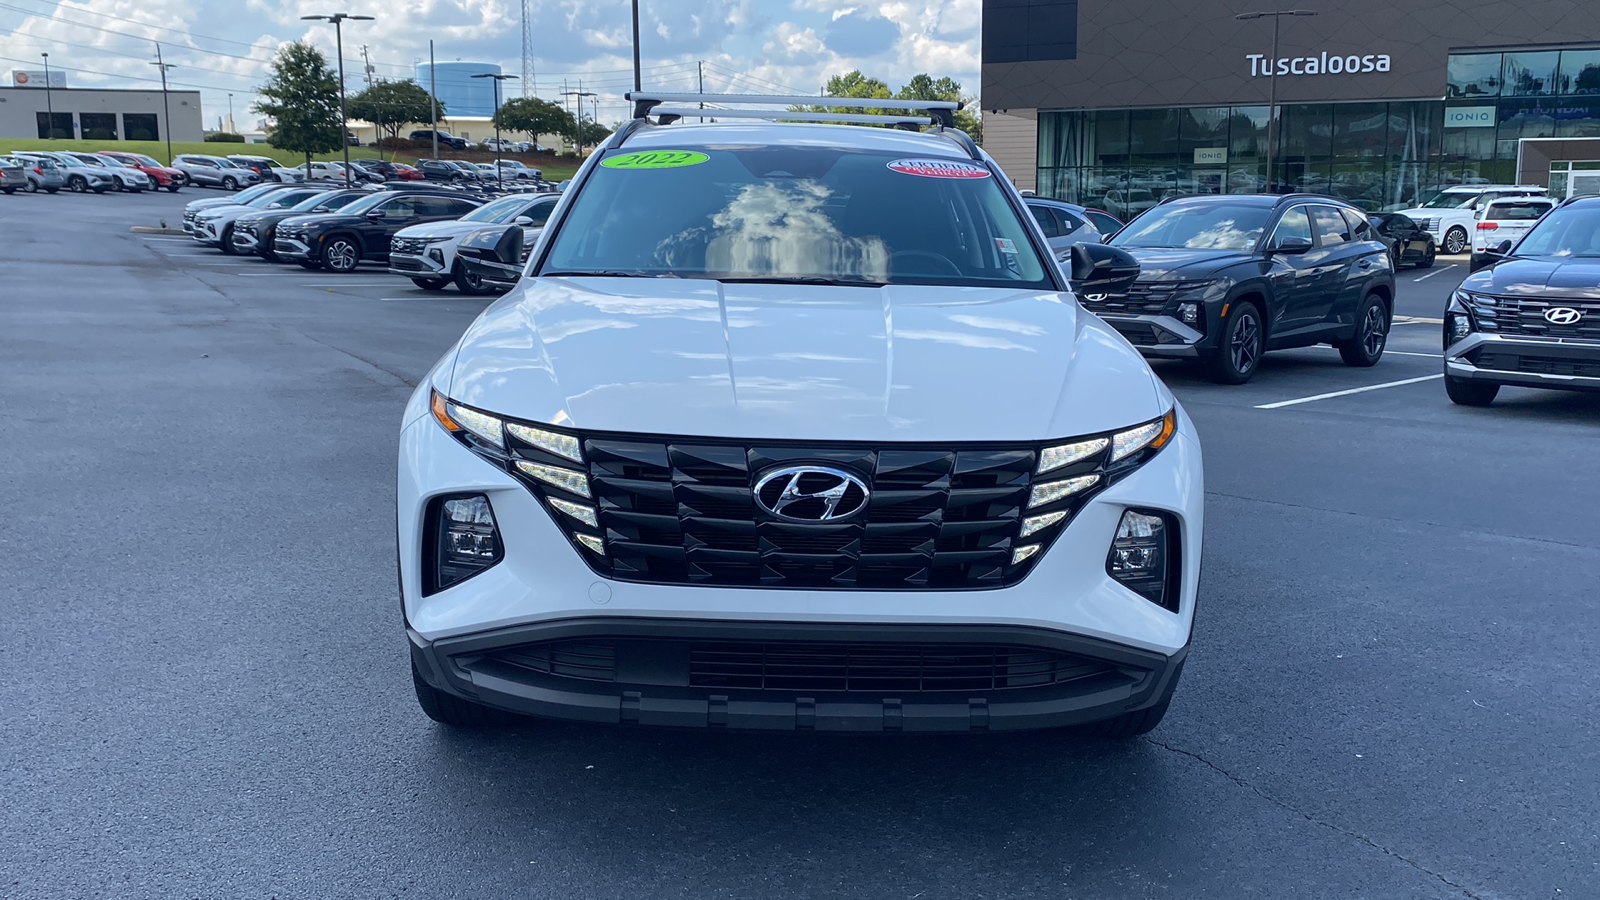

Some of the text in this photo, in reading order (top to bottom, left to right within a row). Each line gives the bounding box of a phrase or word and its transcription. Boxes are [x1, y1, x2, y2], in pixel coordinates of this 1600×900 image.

[1246, 51, 1391, 77] Tuscaloosa
[1450, 112, 1489, 121] IONIQ
[616, 153, 692, 166] 2022
[898, 161, 977, 171] CERTIFIED
